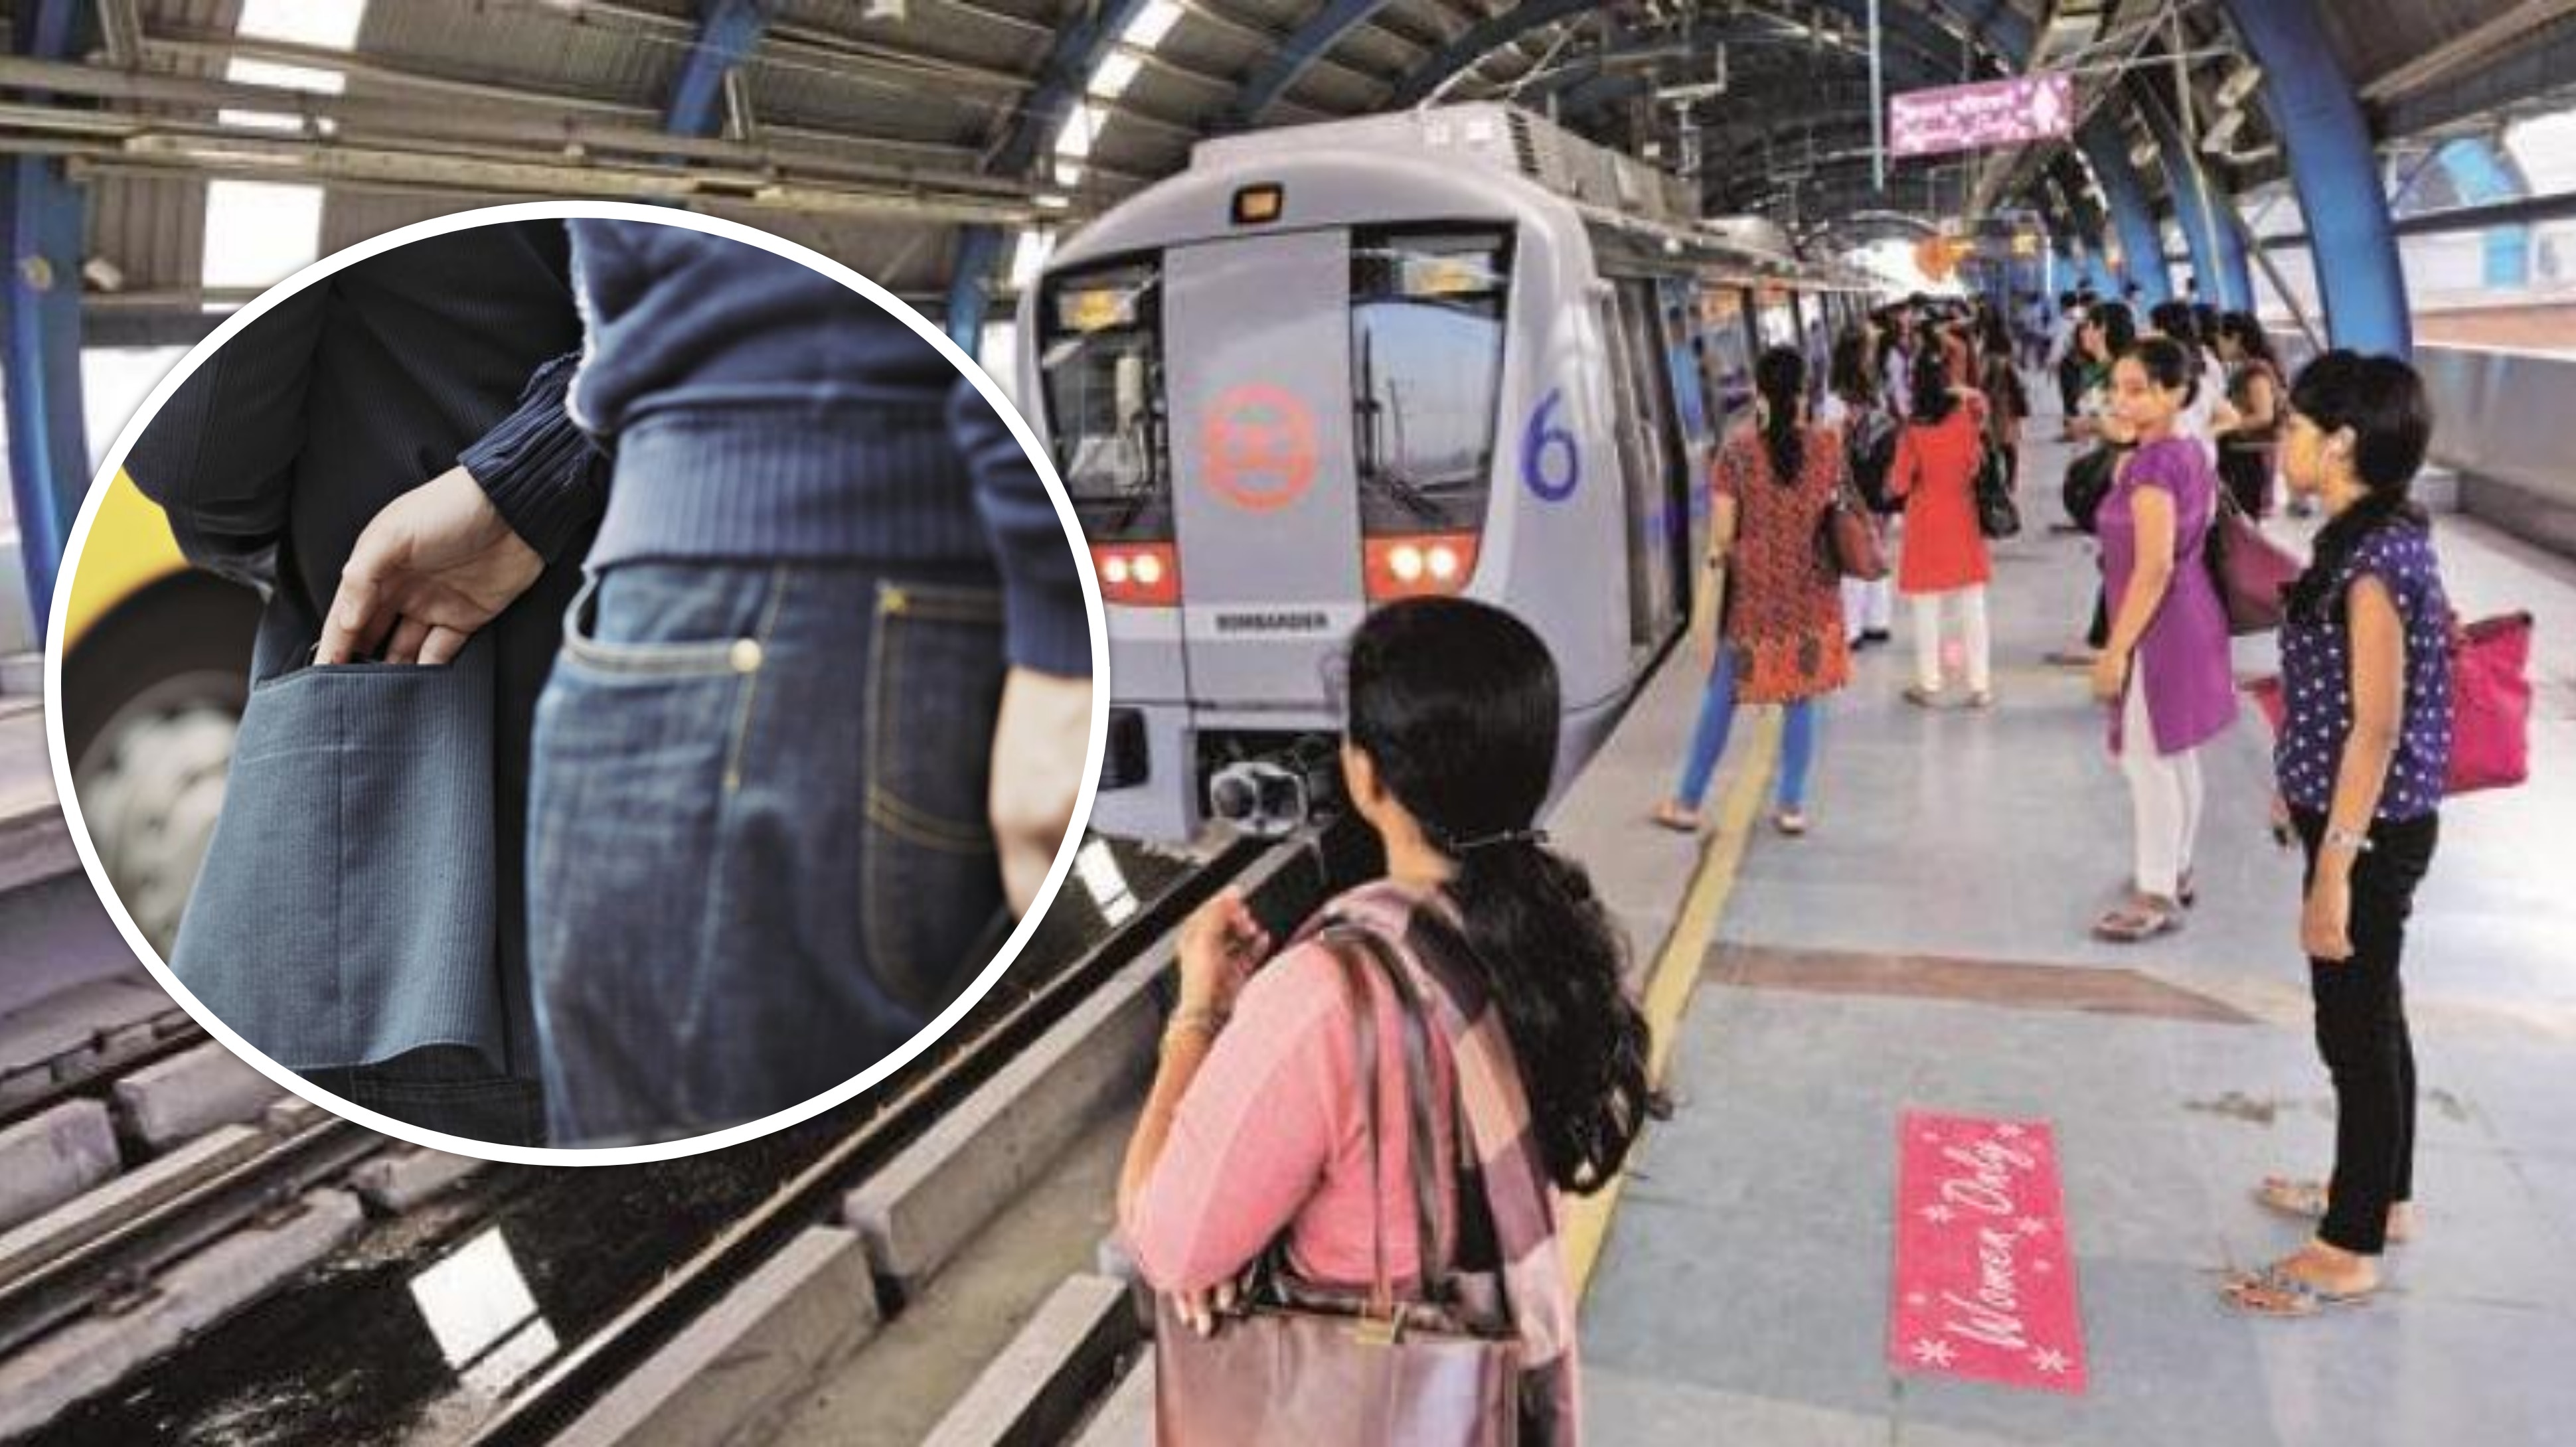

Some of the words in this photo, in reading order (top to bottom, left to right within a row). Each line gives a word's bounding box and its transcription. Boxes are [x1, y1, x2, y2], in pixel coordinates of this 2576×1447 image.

[1522, 387, 1578, 501] 6
[1940, 1138, 2036, 1215] Only
[1941, 1227, 2029, 1349] Women
